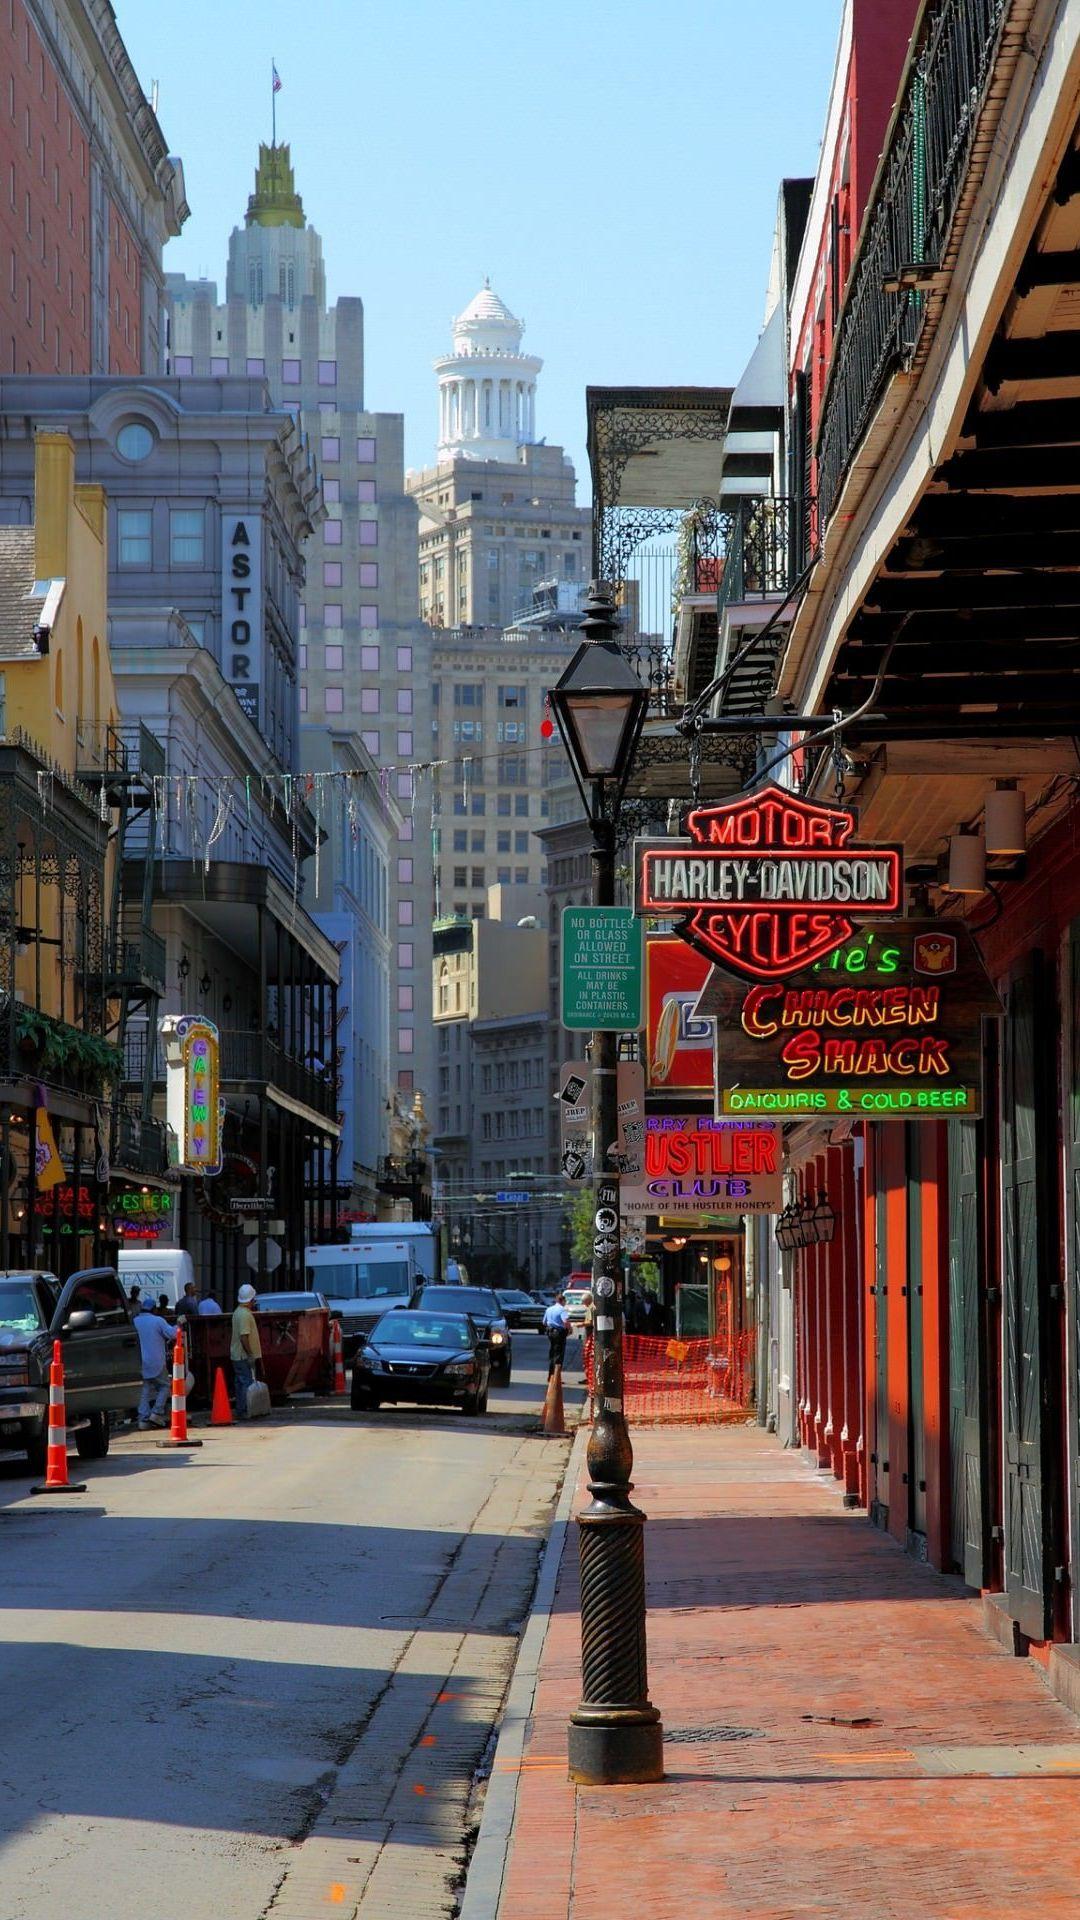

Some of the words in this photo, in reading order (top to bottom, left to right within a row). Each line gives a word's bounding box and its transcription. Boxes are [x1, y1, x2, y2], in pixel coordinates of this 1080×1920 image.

[231, 521, 251, 679] ASTOR
[711, 801, 832, 846] MOTOR
[654, 859, 890, 901] HARLEY-DAVIDSON
[571, 919, 585, 928] NO
[590, 919, 634, 929] BOTTLES
[577, 930, 591, 940] OR
[595, 930, 628, 940] GLASS
[708, 913, 832, 966] CYCLES
[579, 942, 626, 952] ALLOWED
[574, 953, 588, 962] ON
[592, 953, 631, 964] STREET
[577, 972, 592, 980] ALL
[596, 972, 628, 980] DRINKS
[586, 982, 604, 990] MAY
[608, 982, 619, 990] BE
[579, 991, 588, 1000] IN
[591, 991, 626, 1000] PLASTIC
[576, 1001, 628, 1010] CONTAINERS
[741, 983, 940, 1039] CHICKEN
[782, 1029, 951, 1080] SHACK
[191, 1040, 209, 1155] GATEWAY
[730, 1092, 827, 1110] DAIQUIRIS
[837, 1090, 853, 1110] &
[861, 1092, 912, 1110] COLD
[918, 1091, 968, 1107] BEER
[646, 1117, 687, 1132] RRY
[645, 1132, 778, 1177] USTLER
[647, 1179, 752, 1198] CLUB
[658, 1202, 671, 1210] OF
[673, 1202, 690, 1210] THE
[693, 1202, 732, 1210] HUSTLER
[122, 1273, 164, 1285] EANS
